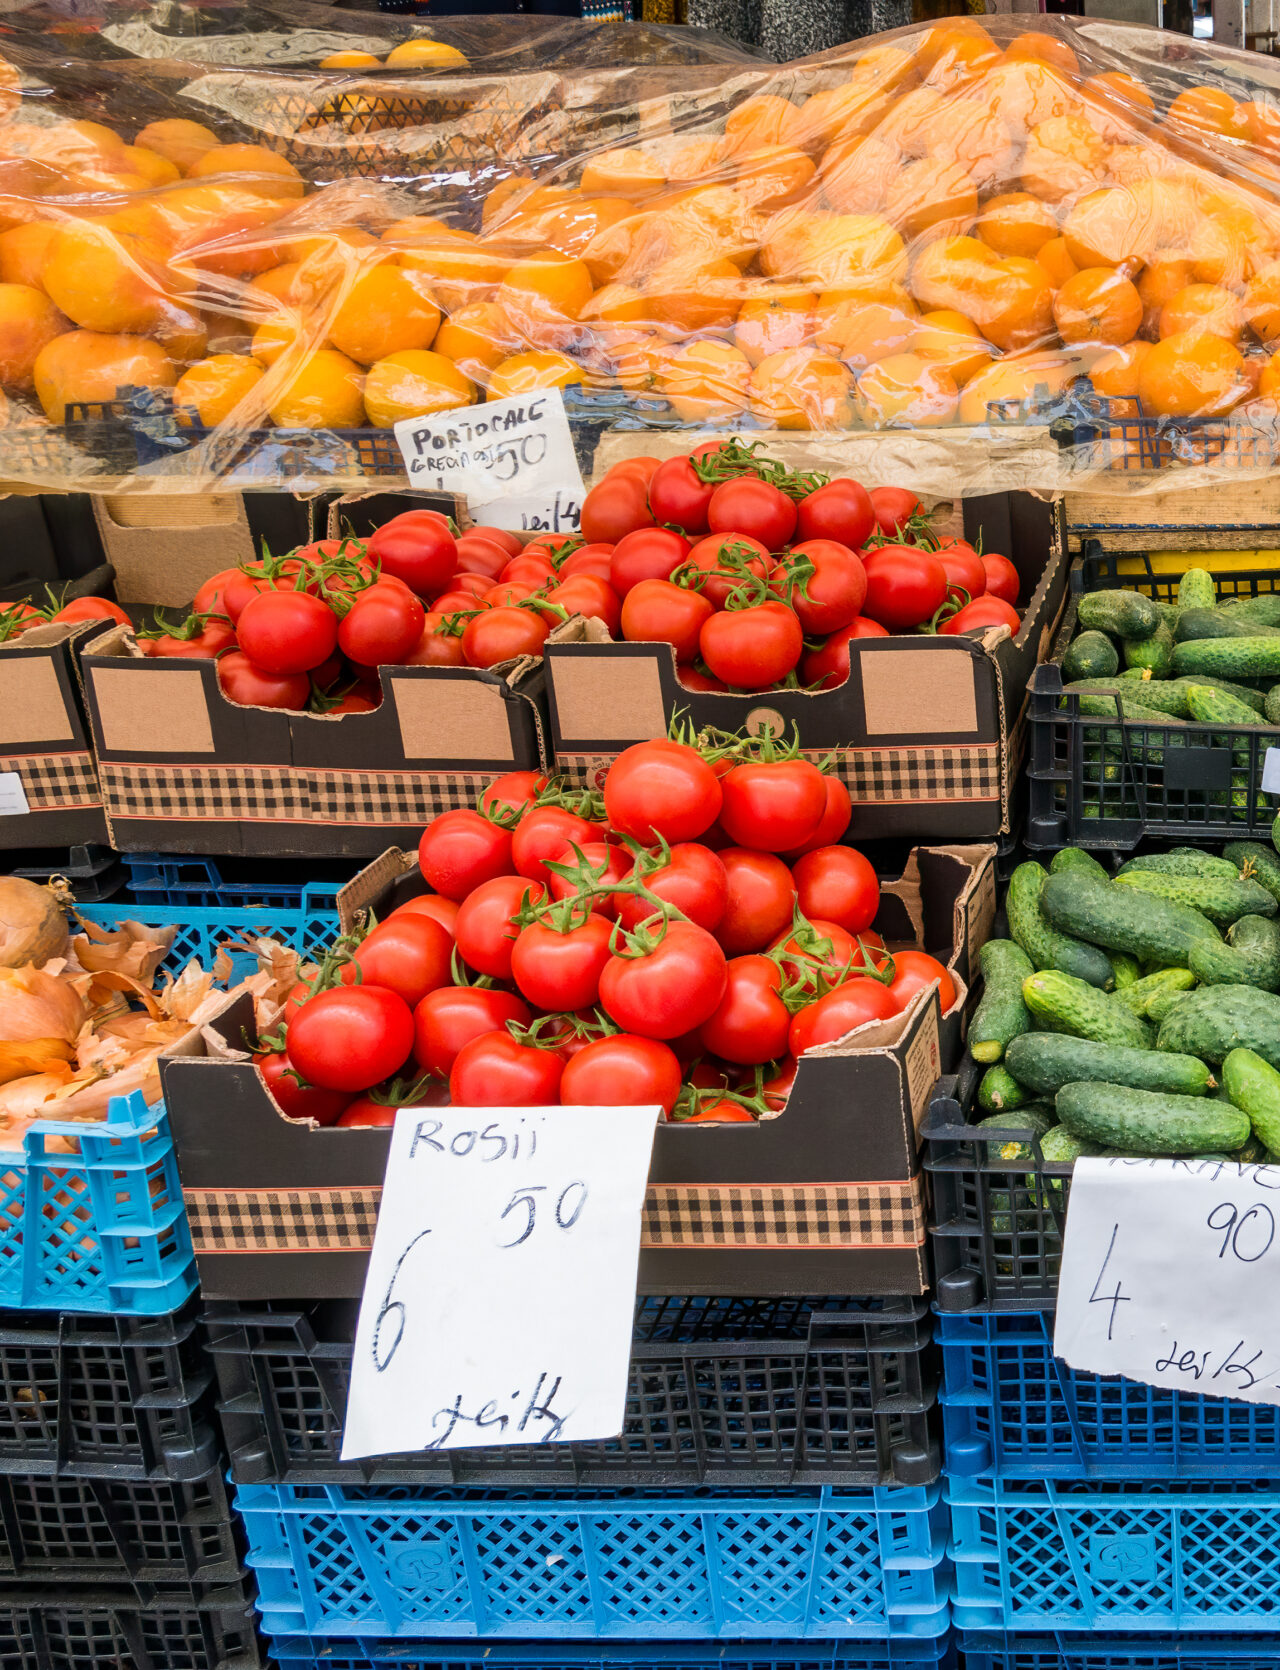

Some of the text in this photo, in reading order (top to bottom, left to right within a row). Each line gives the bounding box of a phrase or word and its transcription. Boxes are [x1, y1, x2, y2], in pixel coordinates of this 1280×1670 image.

[497, 1180, 588, 1248] 50
[1207, 1202, 1275, 1262] 90
[373, 1229, 432, 1372] 6
[1089, 1223, 1131, 1340] 4
